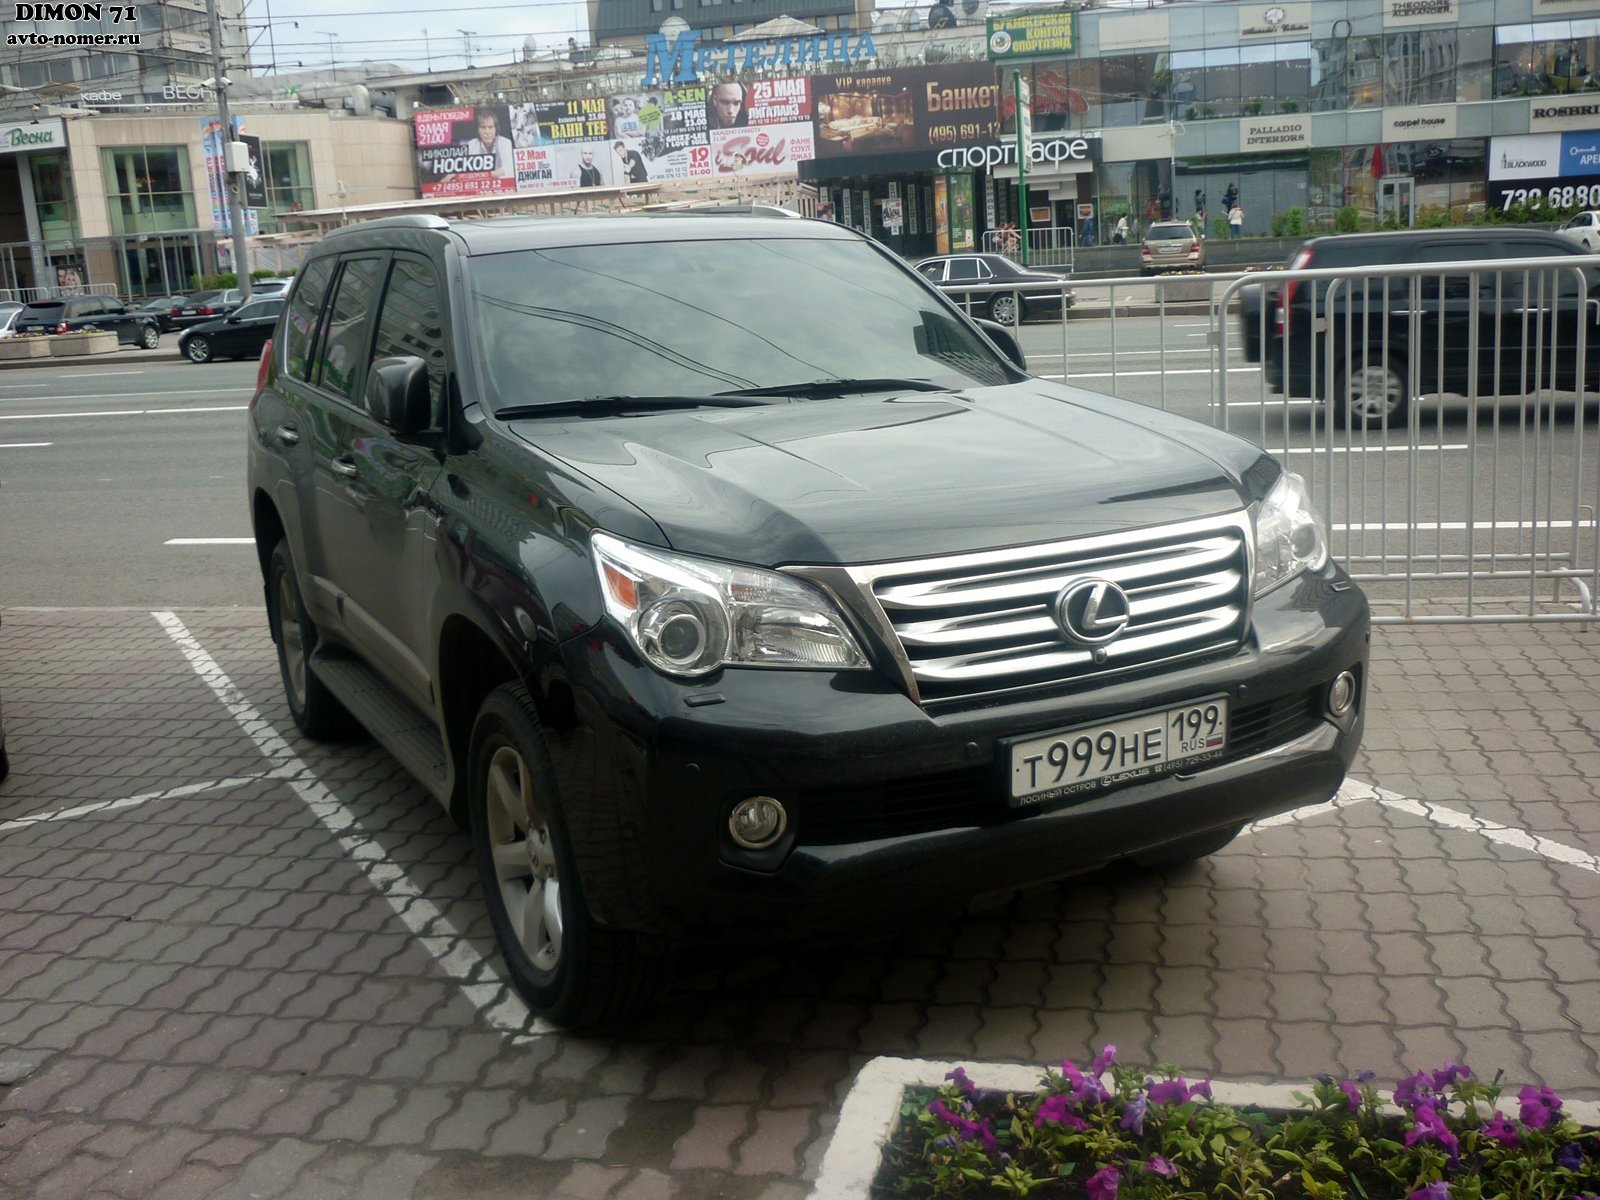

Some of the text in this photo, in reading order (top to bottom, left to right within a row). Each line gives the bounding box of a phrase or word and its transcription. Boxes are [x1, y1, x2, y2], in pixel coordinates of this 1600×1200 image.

[1026, 25, 1072, 39] КОНТОРА
[753, 78, 806, 99] 25 МАЯ
[835, 75, 892, 89] VIP караоке
[80, 85, 218, 103] кафе ВЕСН
[926, 81, 999, 112] Банкет
[567, 100, 578, 115] 11
[581, 98, 606, 115] МАЯ
[684, 109, 706, 119] МАЯ
[426, 122, 449, 134] МАЯ
[1249, 124, 1302, 135] PALLADIO
[1393, 118, 1420, 128] carpet
[1420, 117, 1446, 126] house
[7, 127, 54, 146] Весна
[928, 125, 957, 144] (495)
[1247, 134, 1305, 145] INTERIORS
[423, 145, 468, 160] НИКОЛАЙ
[515, 149, 546, 162] 12 Мая
[690, 147, 709, 162] 19
[790, 145, 811, 153] СОУЛ
[790, 153, 812, 161] ДЖАЗ
[1507, 159, 1546, 169] BLACKWOOD
[1580, 153, 1600, 165] АРЕ
[433, 155, 495, 174] НОСКОВ
[689, 161, 710, 169] МАЯ
[517, 168, 553, 183] ДЖИГАН
[1023, 704, 1219, 788] Т999НЕ 199
[1181, 738, 1205, 753] RUS
[1020, 789, 1062, 805] ЛОСИНЫЙ
[1063, 781, 1097, 795] ОСТРОВ
[1112, 767, 1150, 782] LEXUS
